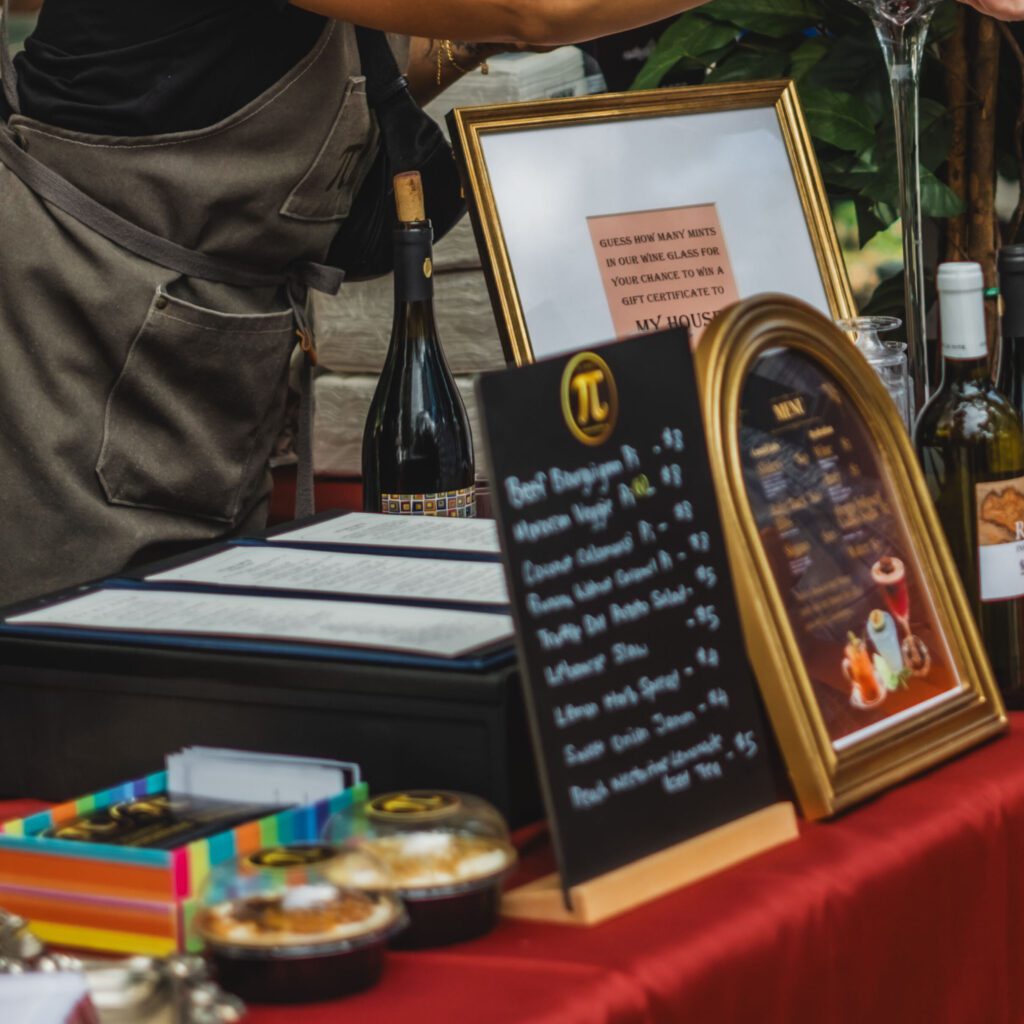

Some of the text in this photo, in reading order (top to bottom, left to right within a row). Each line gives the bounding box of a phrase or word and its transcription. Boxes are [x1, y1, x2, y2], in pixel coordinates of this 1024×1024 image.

[599, 227, 717, 248] GUESS HOW MANY MINTS
[606, 246, 720, 268] IN OUR WINE GLASS FOR
[611, 266, 725, 288] YOUR CHANCE TO WIN A
[621, 285, 725, 306] GIFT CERTIFICATE TO
[636, 315, 662, 332] MY
[695, 605, 720, 631] $5
[734, 731, 758, 758] $5
